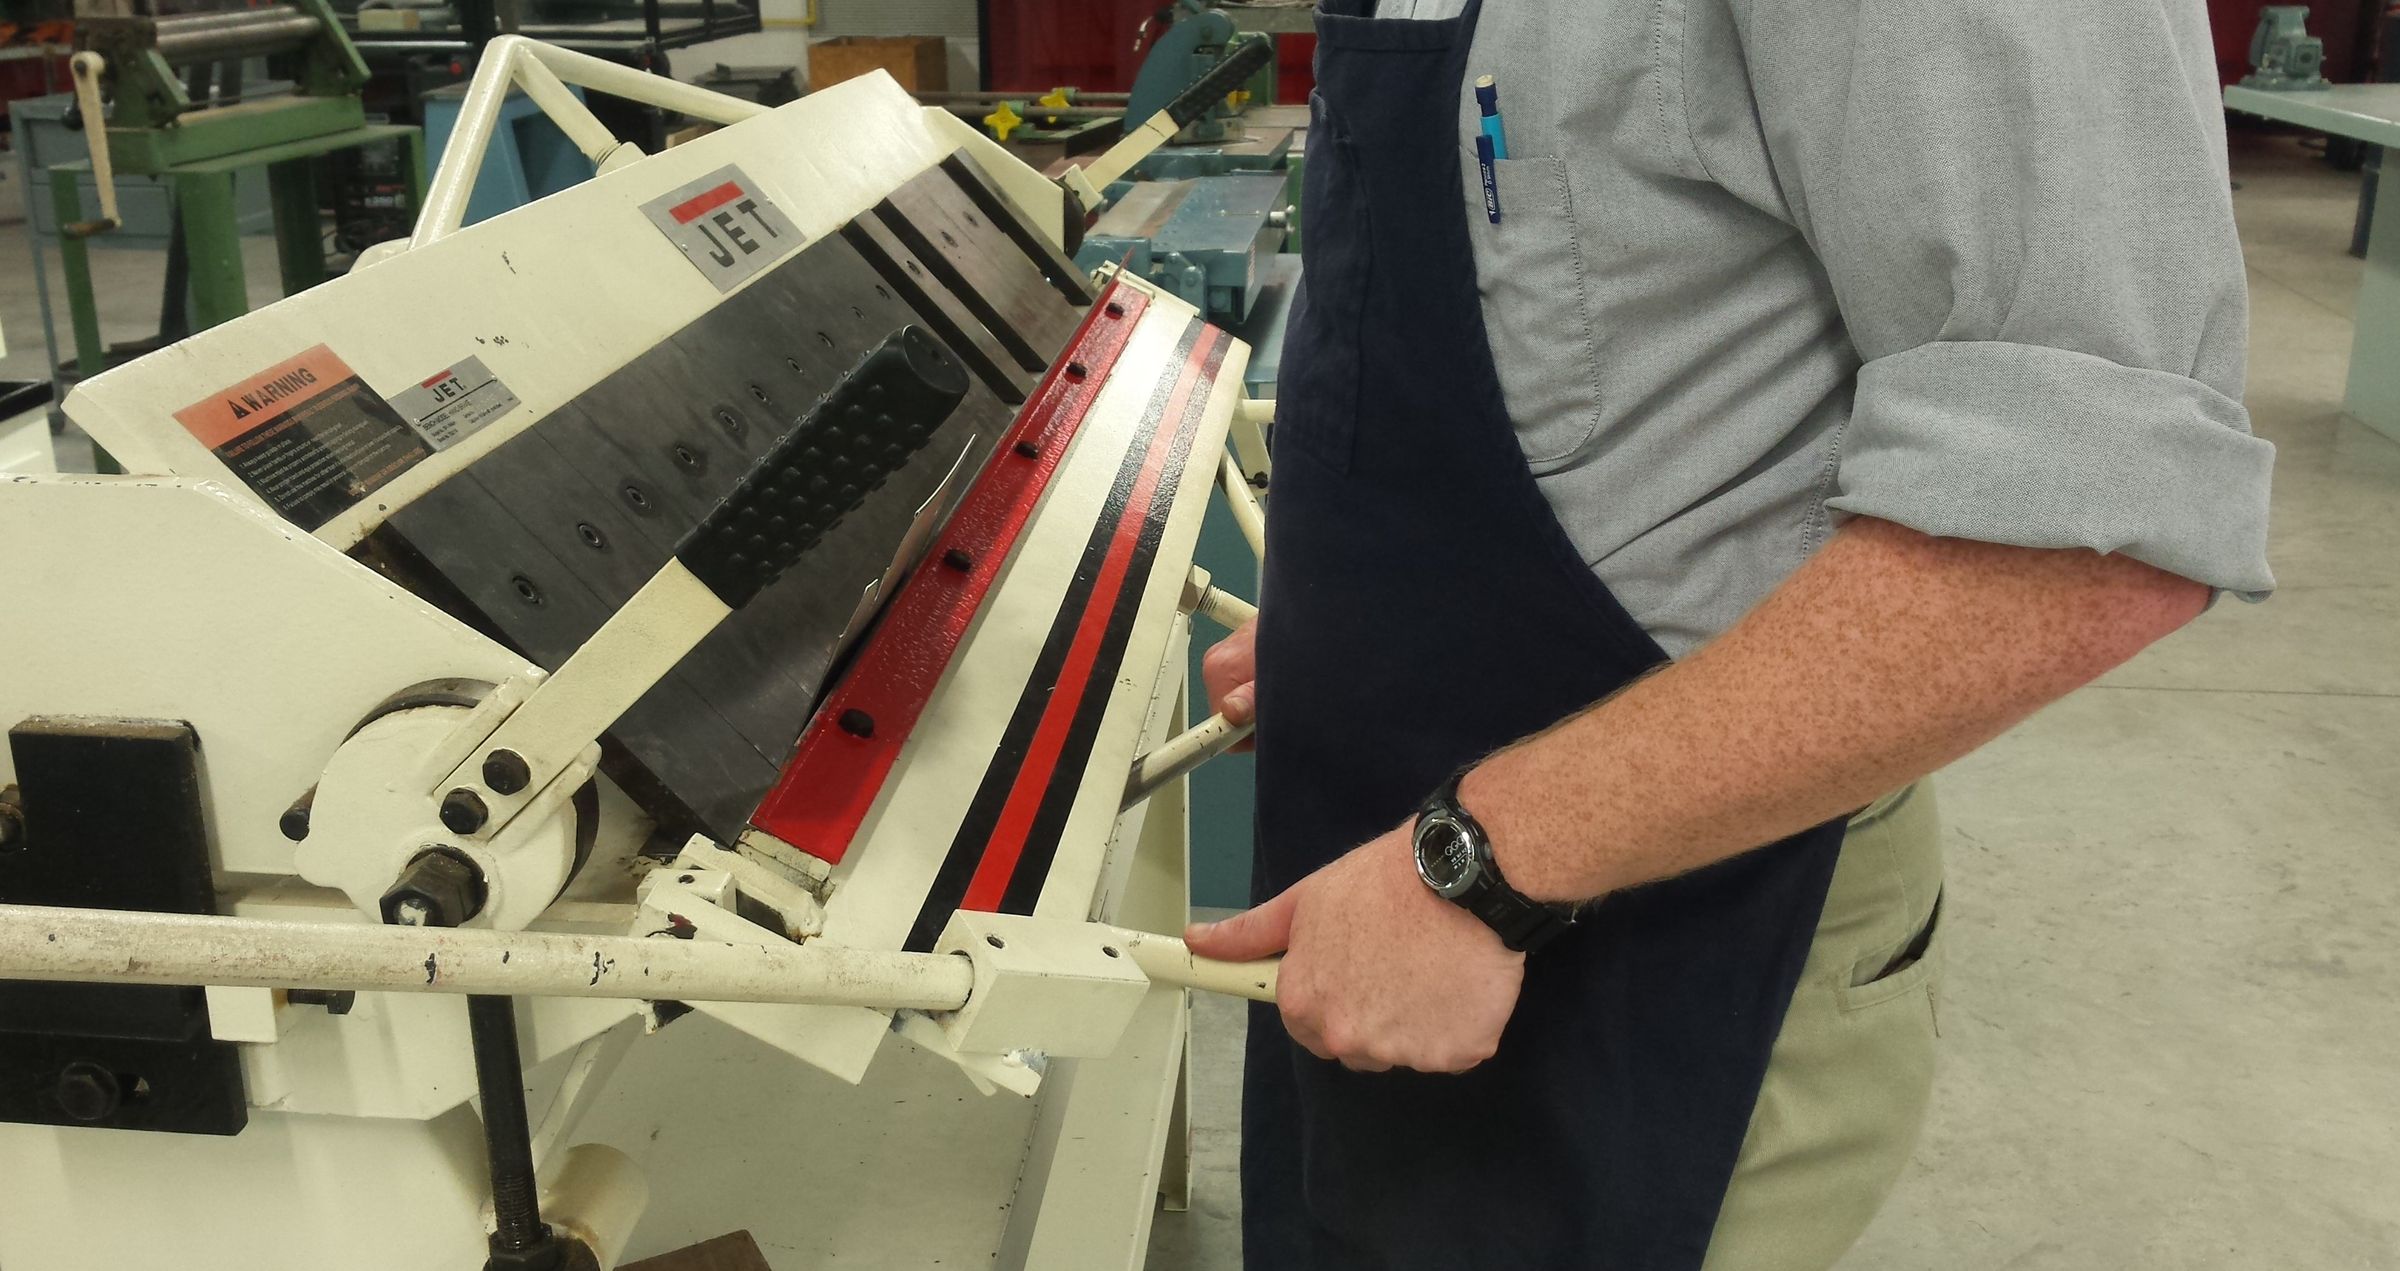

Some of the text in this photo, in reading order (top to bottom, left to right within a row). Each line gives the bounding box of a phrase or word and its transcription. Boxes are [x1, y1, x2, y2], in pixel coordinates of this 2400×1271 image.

[698, 199, 778, 267] JET
[241, 368, 317, 411] WARNING
[433, 377, 464, 402] JET
